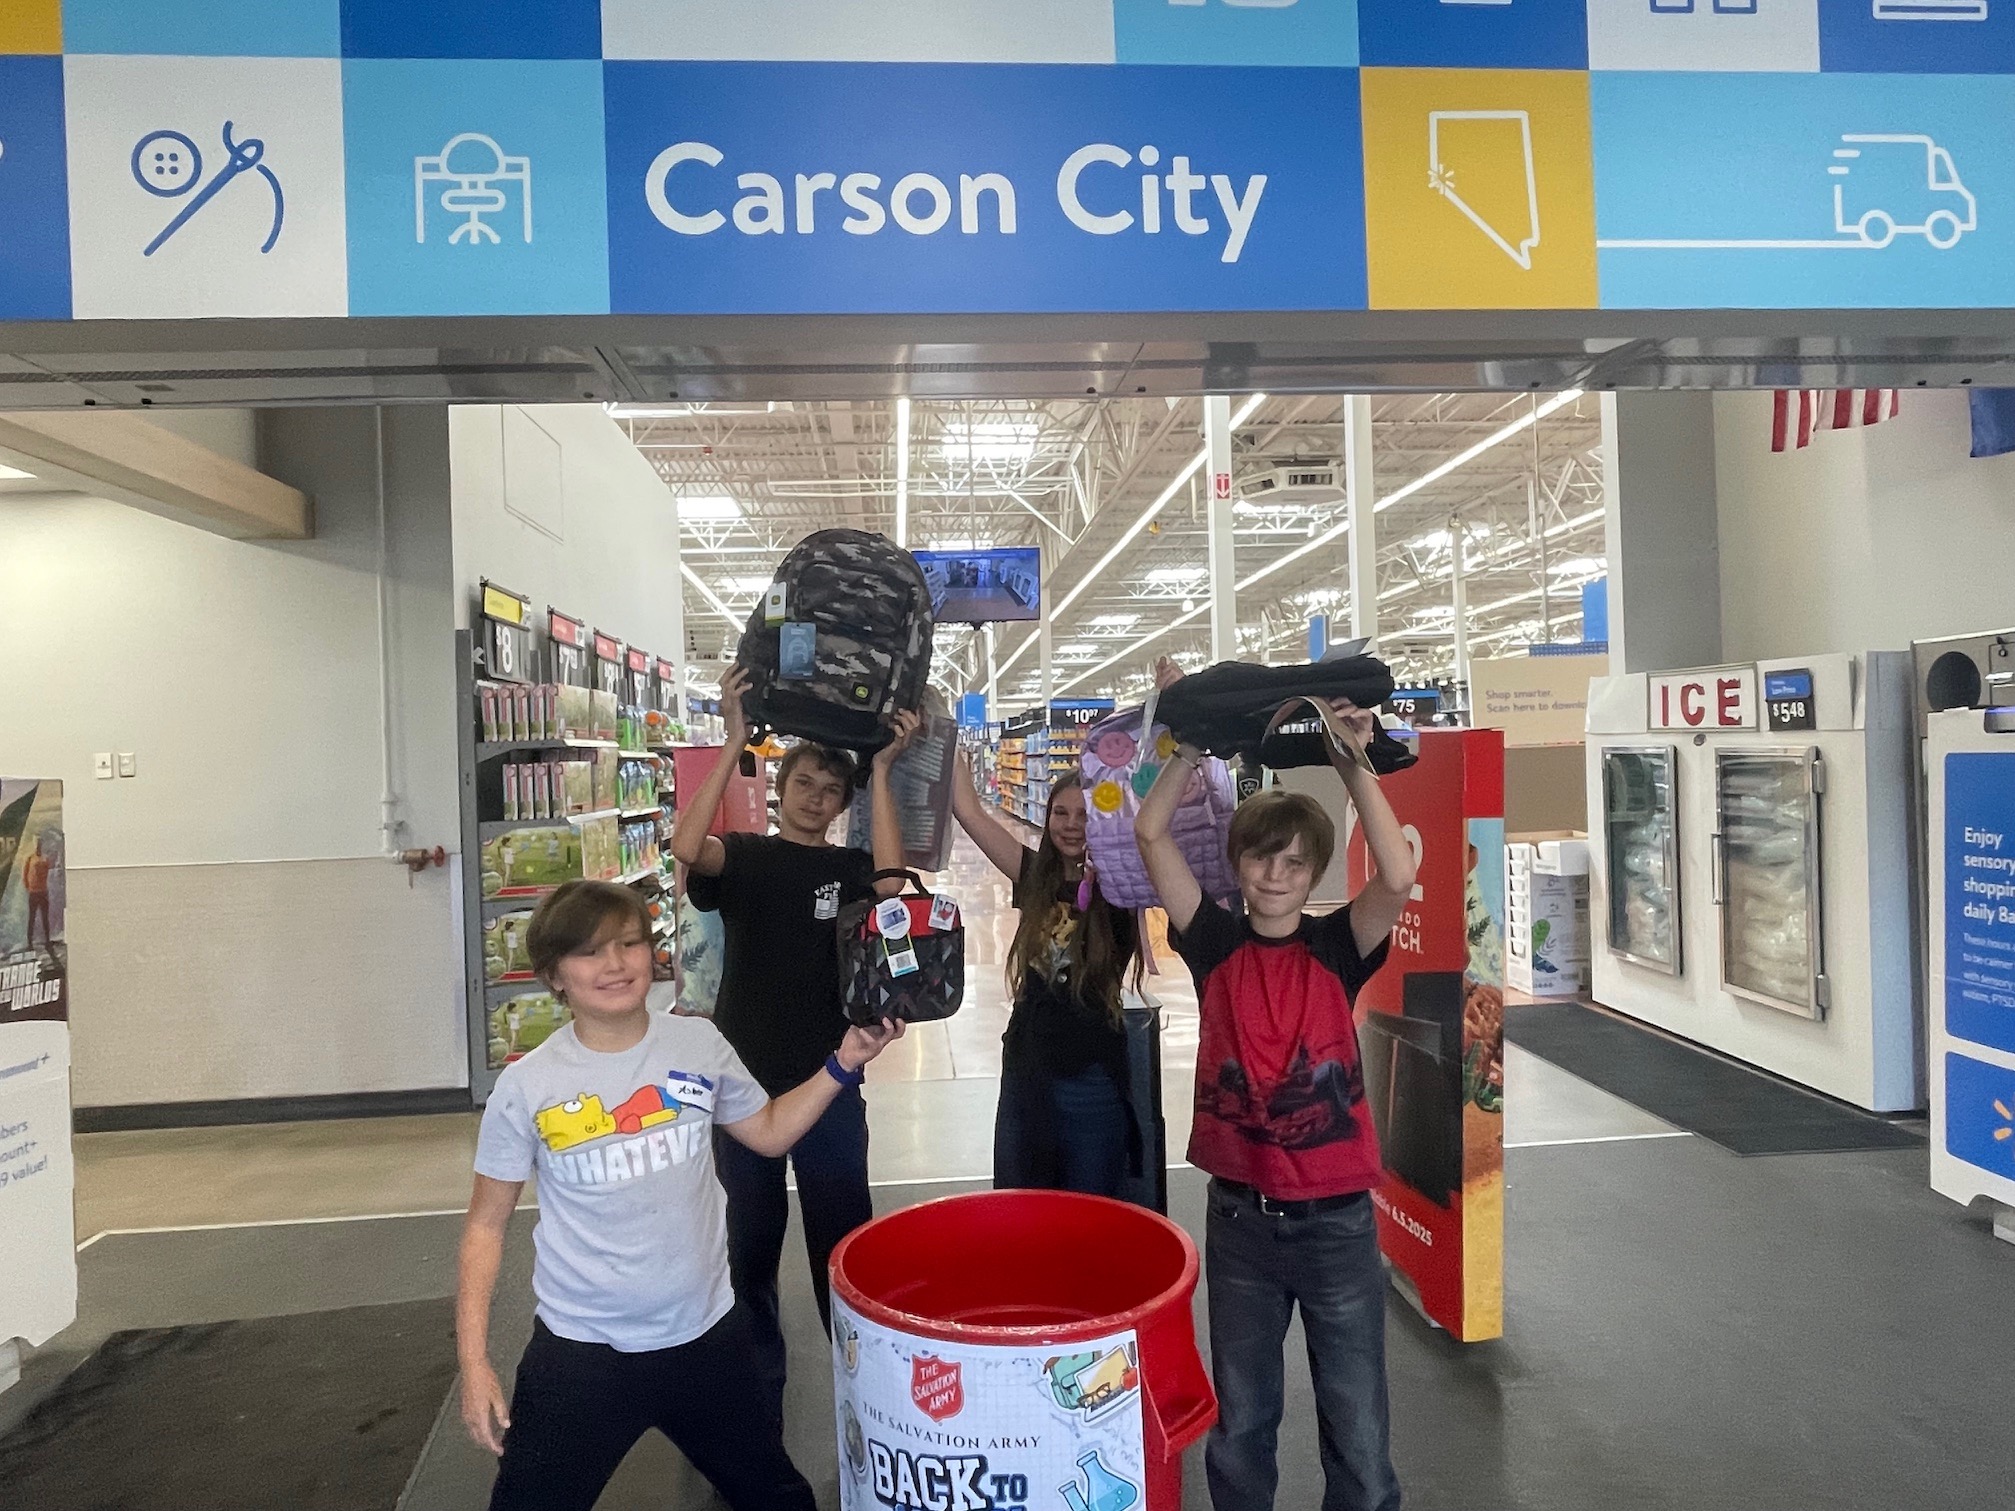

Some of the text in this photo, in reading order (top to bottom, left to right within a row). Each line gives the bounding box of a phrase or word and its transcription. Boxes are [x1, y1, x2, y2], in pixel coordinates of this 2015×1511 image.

[644, 141, 1268, 263] Carson City
[1485, 690, 1511, 700] Shop
[1486, 703, 1510, 713] Scan
[1513, 703, 1536, 711] here
[1538, 703, 1549, 711] to
[1661, 678, 1742, 726] ICE
[1964, 827, 2003, 850] Enjoy
[1963, 855, 2015, 876] sensory
[1963, 902, 1996, 925] daily
[11, 979, 60, 1011] WORLDS
[12, 1155, 48, 1181] value!
[1392, 1206, 1433, 1247] 6.5.2025
[913, 1369, 958, 1401] SALVATION
[920, 1363, 939, 1381] THE
[928, 1389, 956, 1413] ARMY
[863, 1401, 1042, 1450] THE SALVATION ARMY
[868, 1438, 1028, 1511] BACK TO
